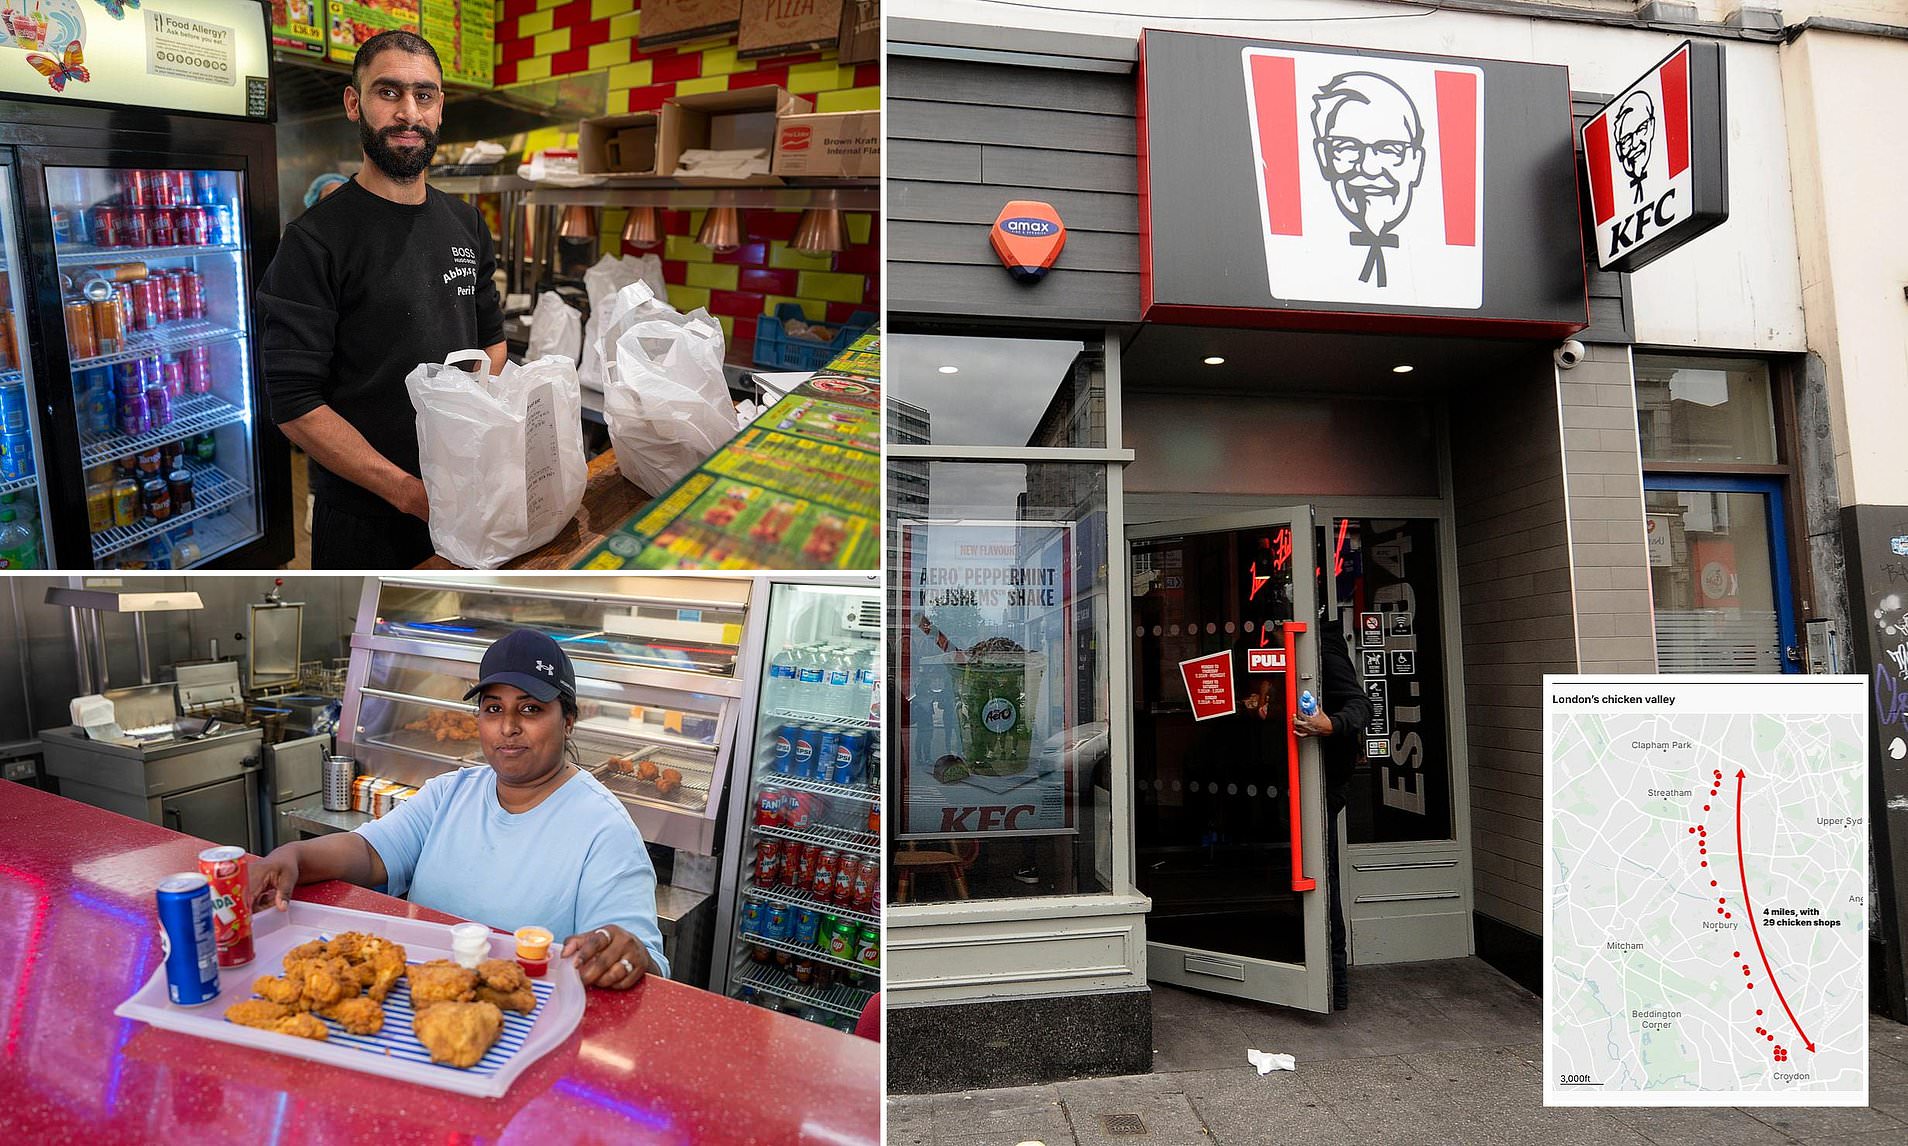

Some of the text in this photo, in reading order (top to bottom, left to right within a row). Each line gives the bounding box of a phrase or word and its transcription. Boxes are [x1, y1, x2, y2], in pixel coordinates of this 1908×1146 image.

[765, 0, 814, 22] PIZZA
[166, 18, 227, 39] Food Allergy?
[167, 28, 179, 36] Ask
[181, 31, 200, 41] before
[823, 137, 878, 146] Brown Kraft
[826, 147, 861, 155] Internal
[1008, 221, 1049, 232] amax
[1609, 188, 1676, 259] KFC
[451, 246, 476, 259] BOSS
[457, 285, 471, 296] Peri
[919, 568, 1055, 586] AERO PEPPERMINT
[1007, 588, 1055, 606] SHAKE
[761, 799, 783, 809] FANT
[940, 805, 1036, 832] KFC
